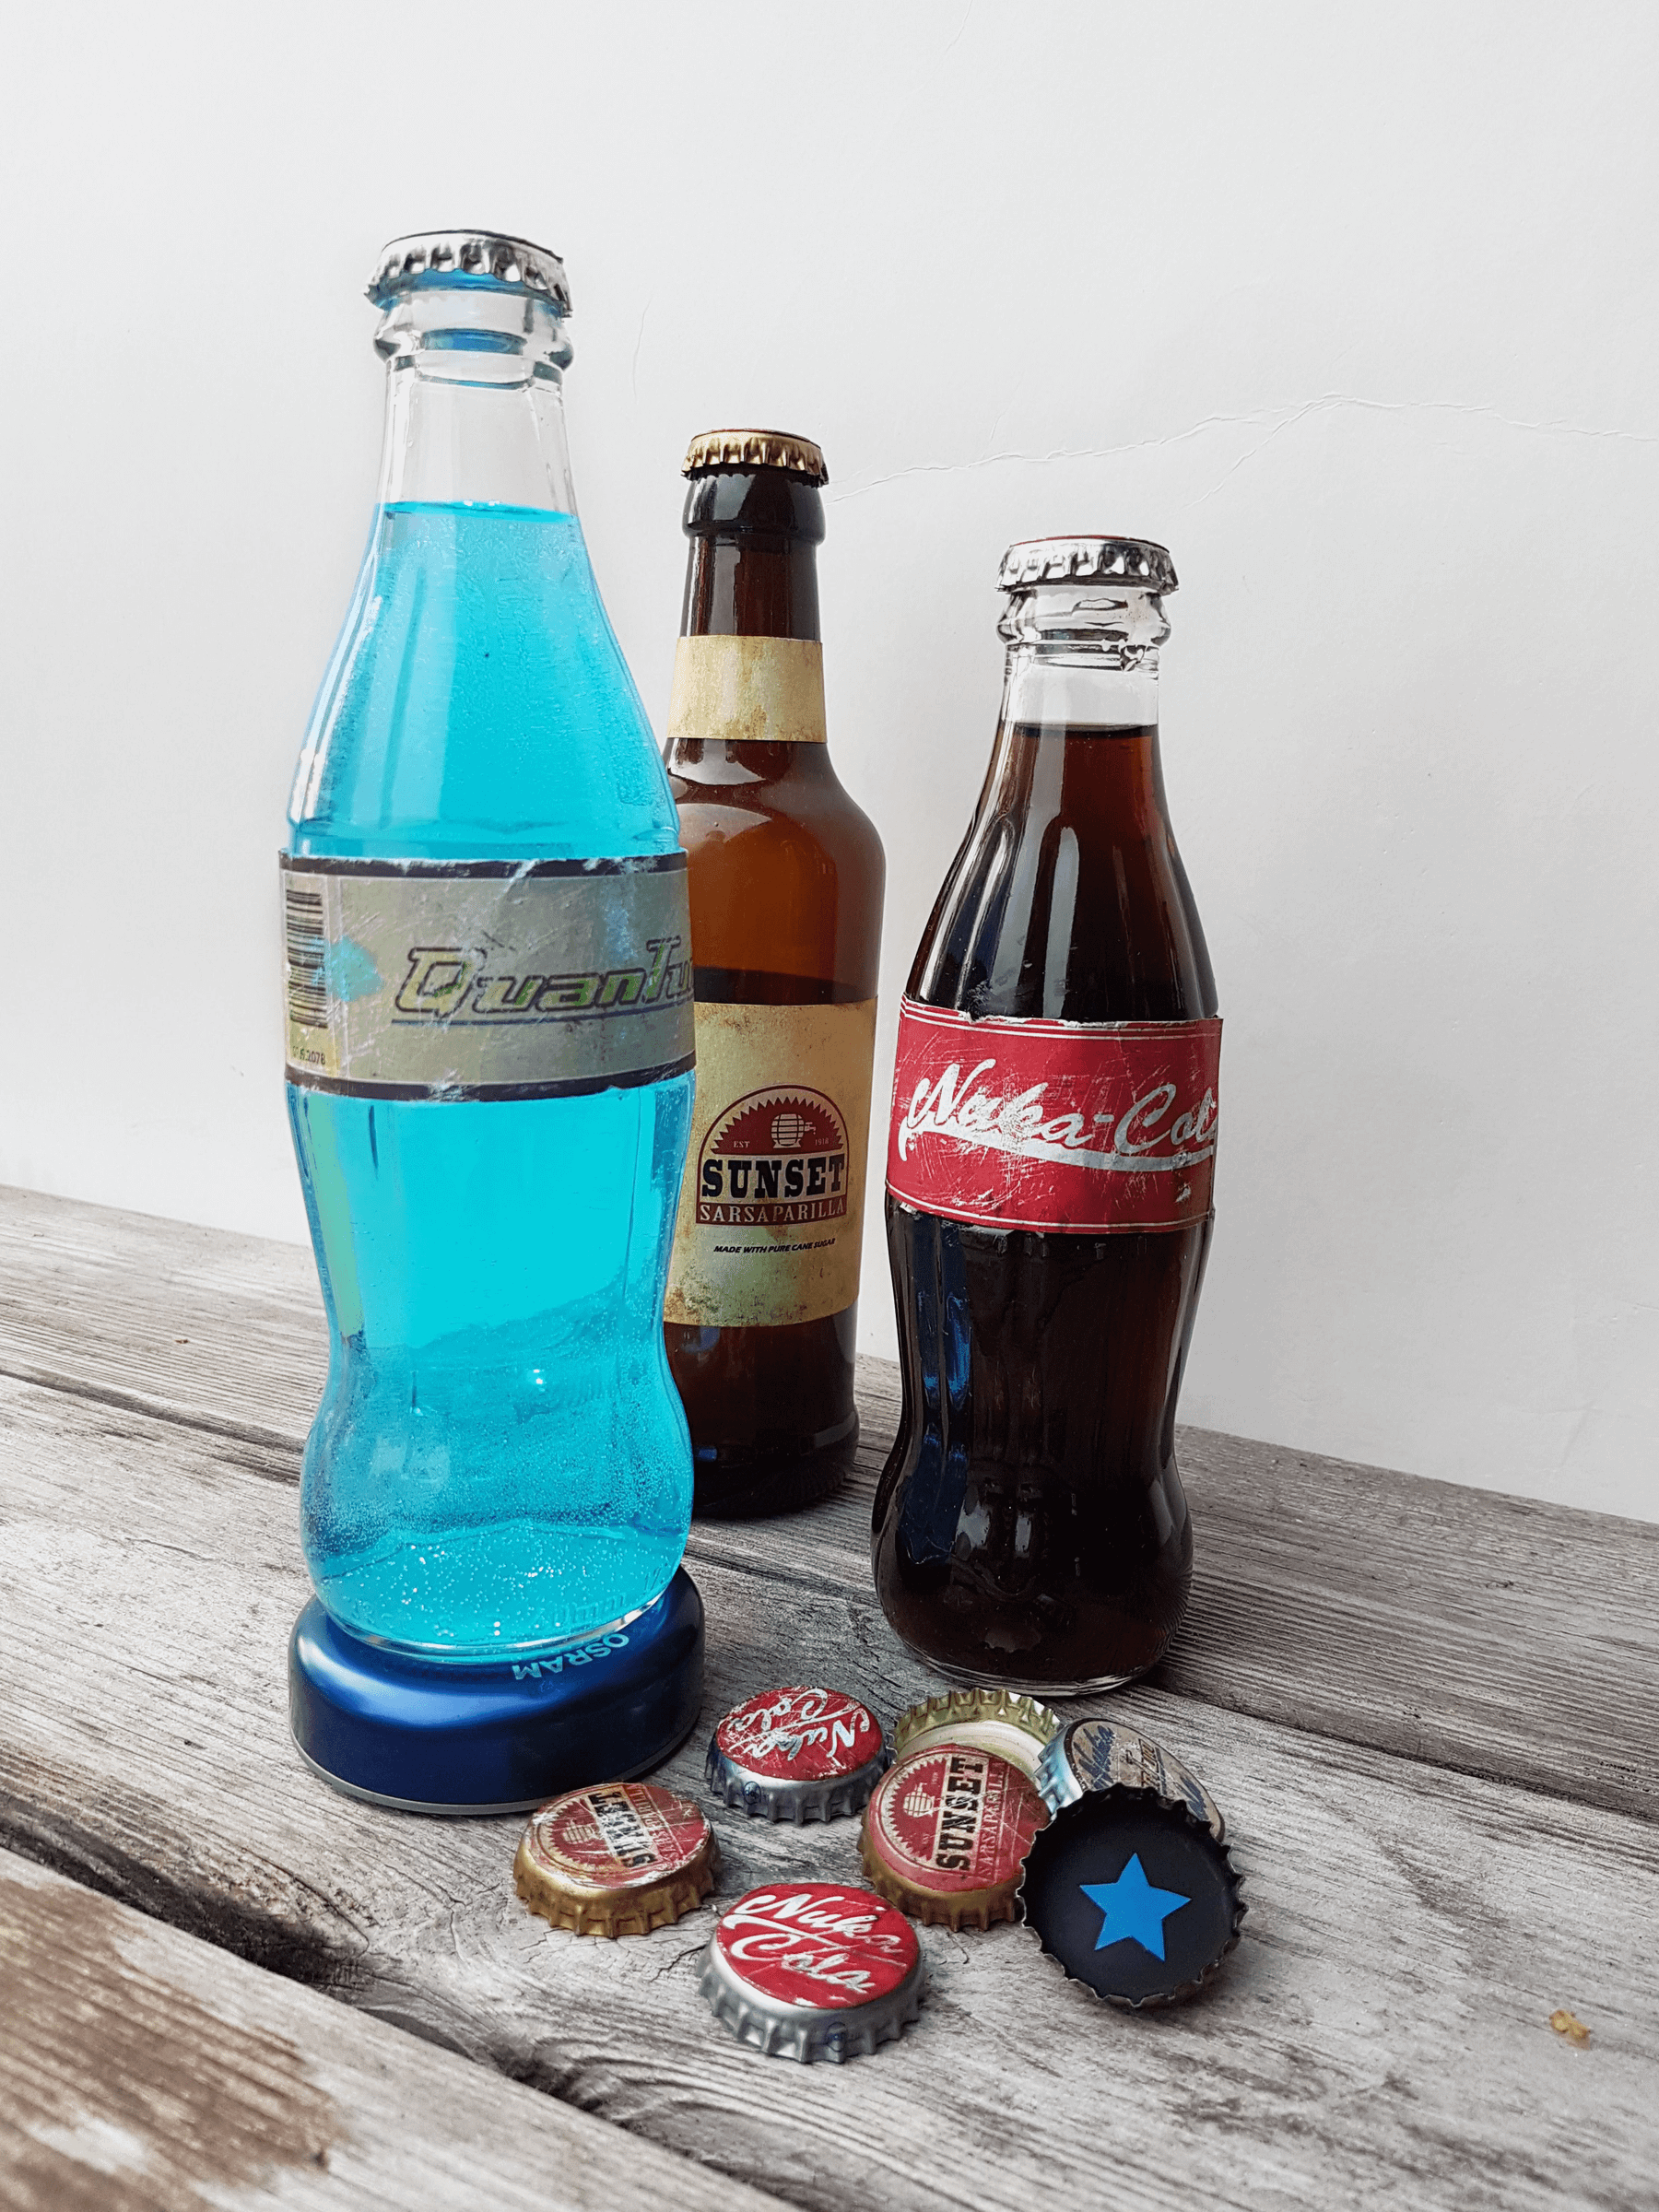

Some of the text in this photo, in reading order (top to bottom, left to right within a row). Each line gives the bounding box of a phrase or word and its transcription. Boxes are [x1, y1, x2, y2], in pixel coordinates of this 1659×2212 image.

[733, 1140, 750, 1148] EST
[701, 1153, 845, 1198] SUNSET
[700, 1198, 844, 1222] SARSAPARILLA
[713, 1245, 742, 1253] MADE
[791, 1241, 813, 1252] CANE
[813, 1238, 836, 1248] SUGAR
[512, 1633, 629, 1680] OSRAM
[935, 1756, 984, 1871] SUNSET
[734, 1893, 905, 1954] Nuka
[730, 1933, 877, 1994] Cola
